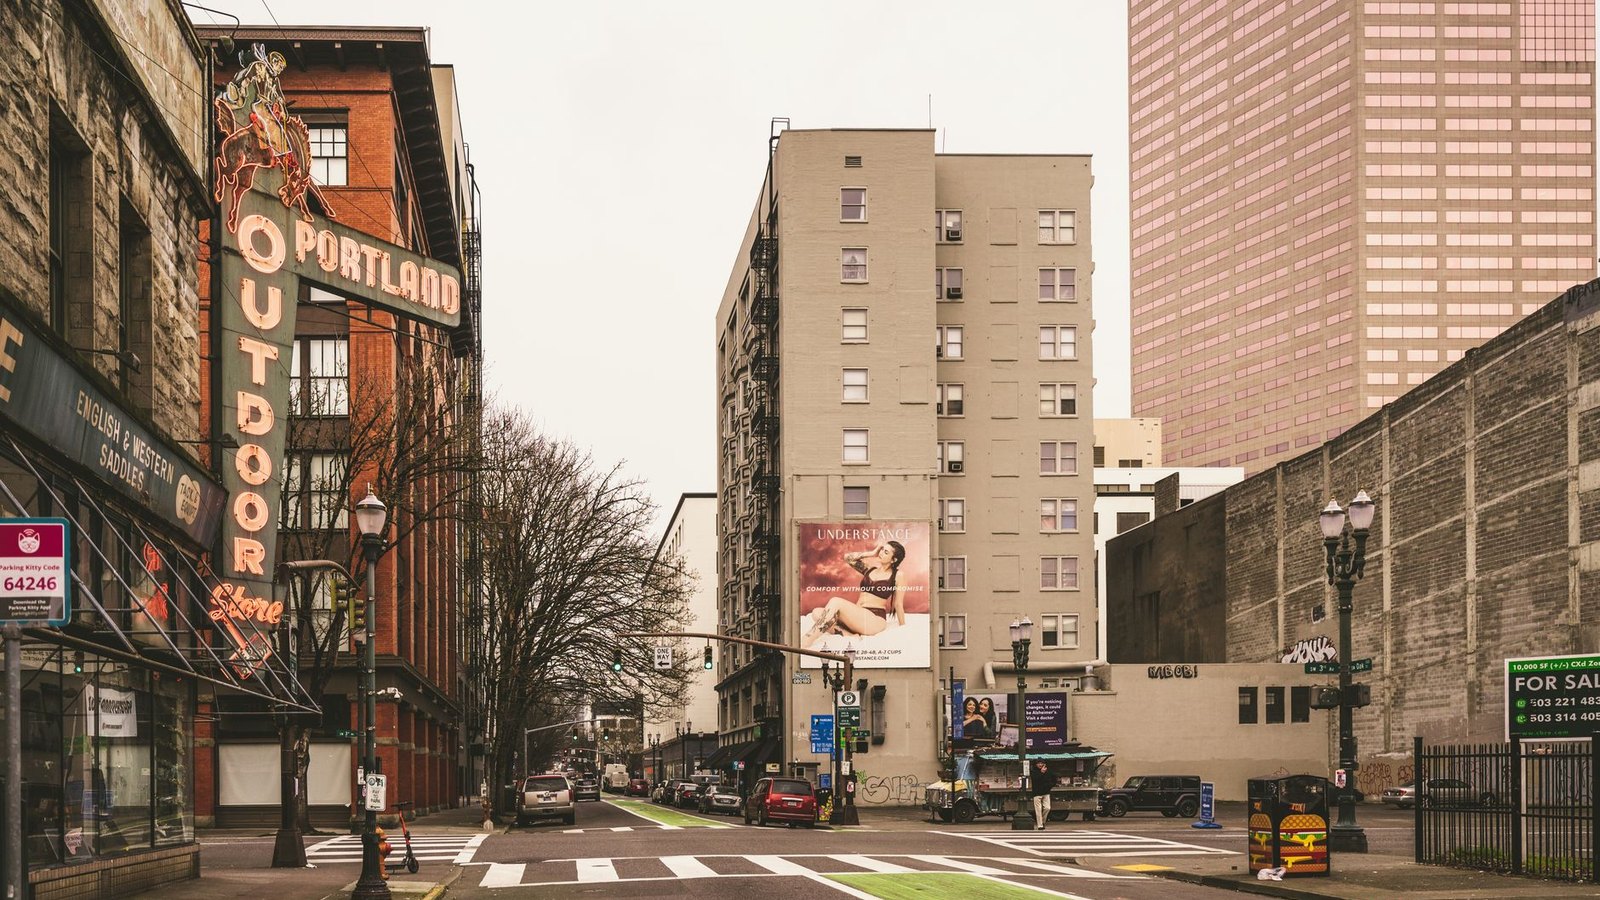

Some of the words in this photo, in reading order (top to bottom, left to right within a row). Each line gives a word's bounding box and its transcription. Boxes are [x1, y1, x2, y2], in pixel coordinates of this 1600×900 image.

[295, 219, 460, 315] PORTLAND
[233, 214, 286, 576] OUTDOOR
[76, 390, 121, 443] ENGLISH
[123, 430, 130, 451] &
[133, 435, 175, 485] WESTERN
[100, 444, 145, 492] SADDLES
[817, 529, 912, 540] UNDERSTANCE
[4, 577, 57, 591] 64246
[208, 583, 284, 624] Store
[1515, 675, 1558, 692] FOR
[1530, 698, 1552, 707] 503
[1555, 697, 1576, 706] 221
[1530, 713, 1552, 722] 503
[1555, 713, 1577, 722] 314
